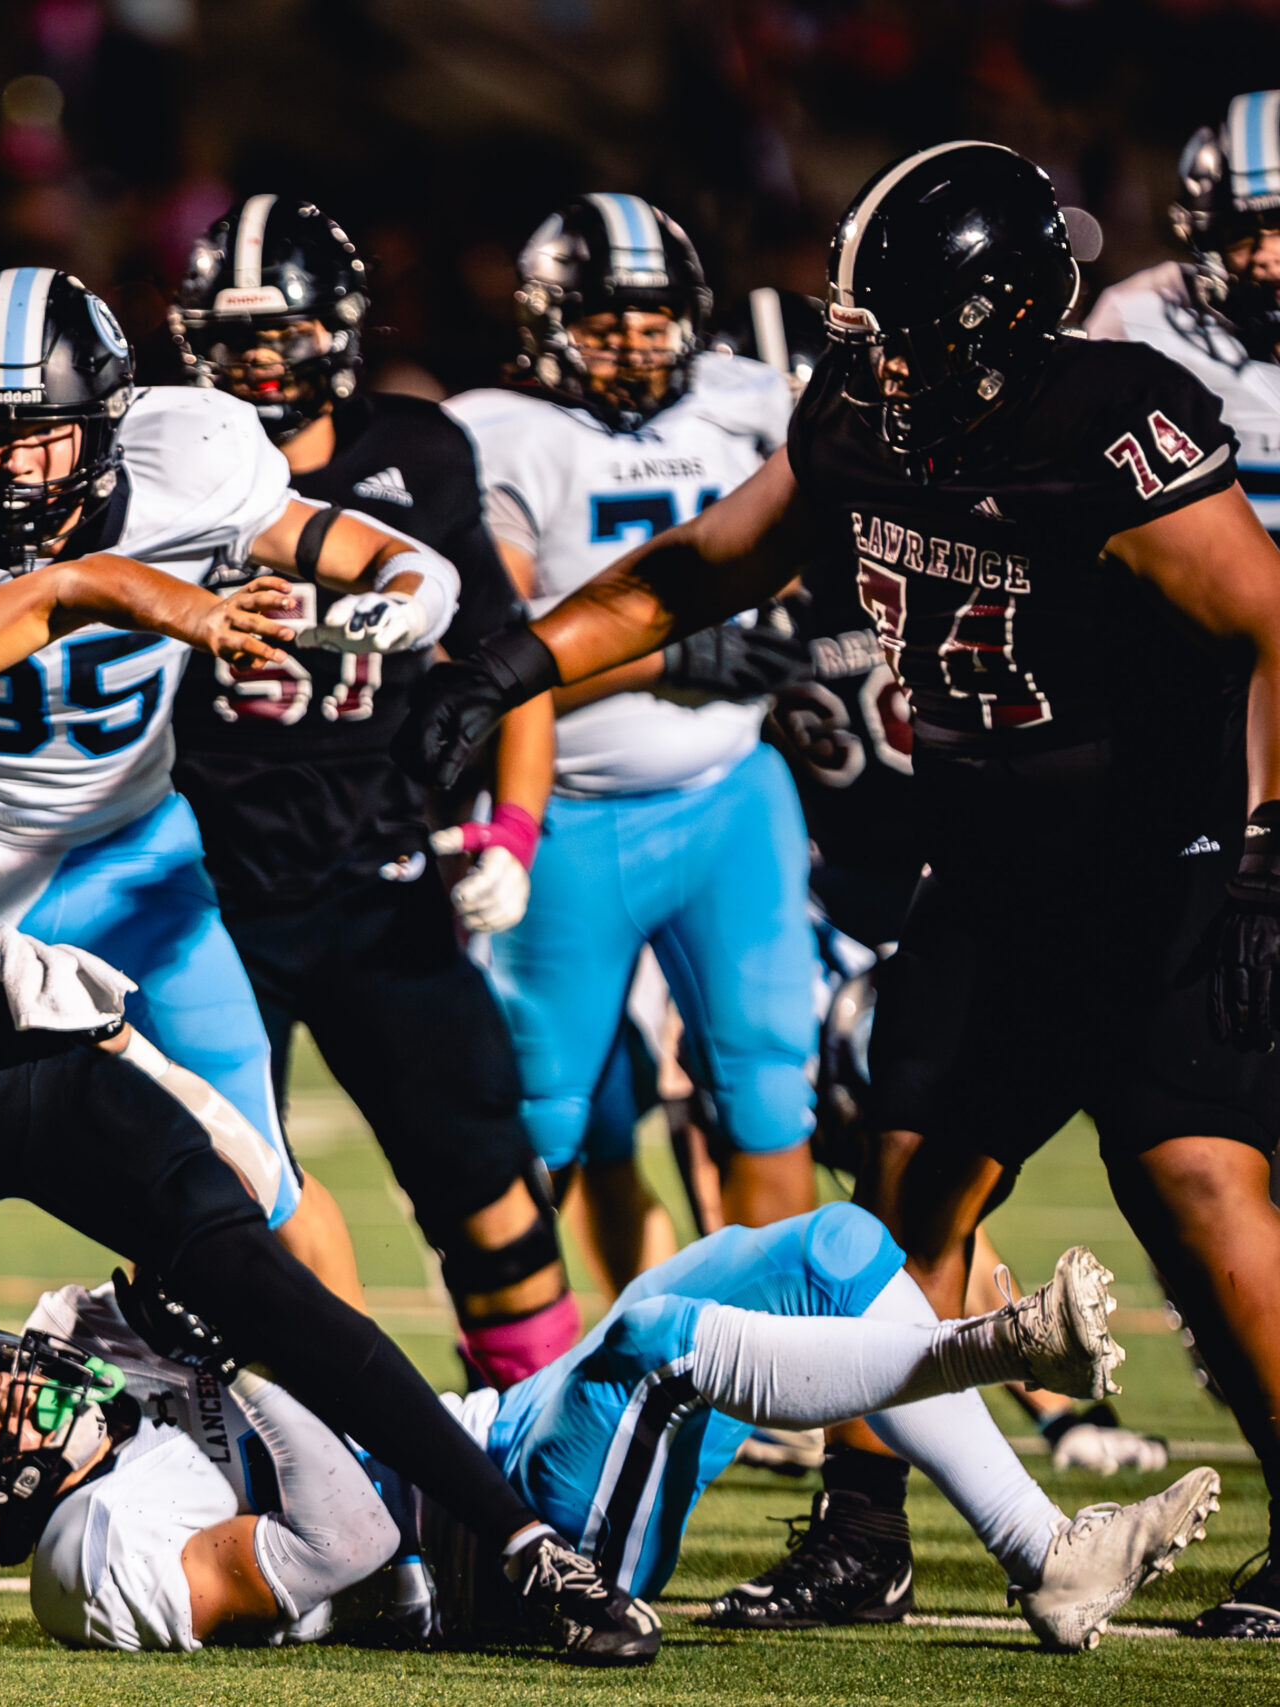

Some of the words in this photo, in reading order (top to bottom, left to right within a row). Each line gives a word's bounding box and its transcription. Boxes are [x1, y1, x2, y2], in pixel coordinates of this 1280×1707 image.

[1104, 409, 1204, 500] 74
[589, 487, 722, 544] 7
[851, 511, 1031, 594] LAWRENCE
[856, 556, 1053, 730] 74
